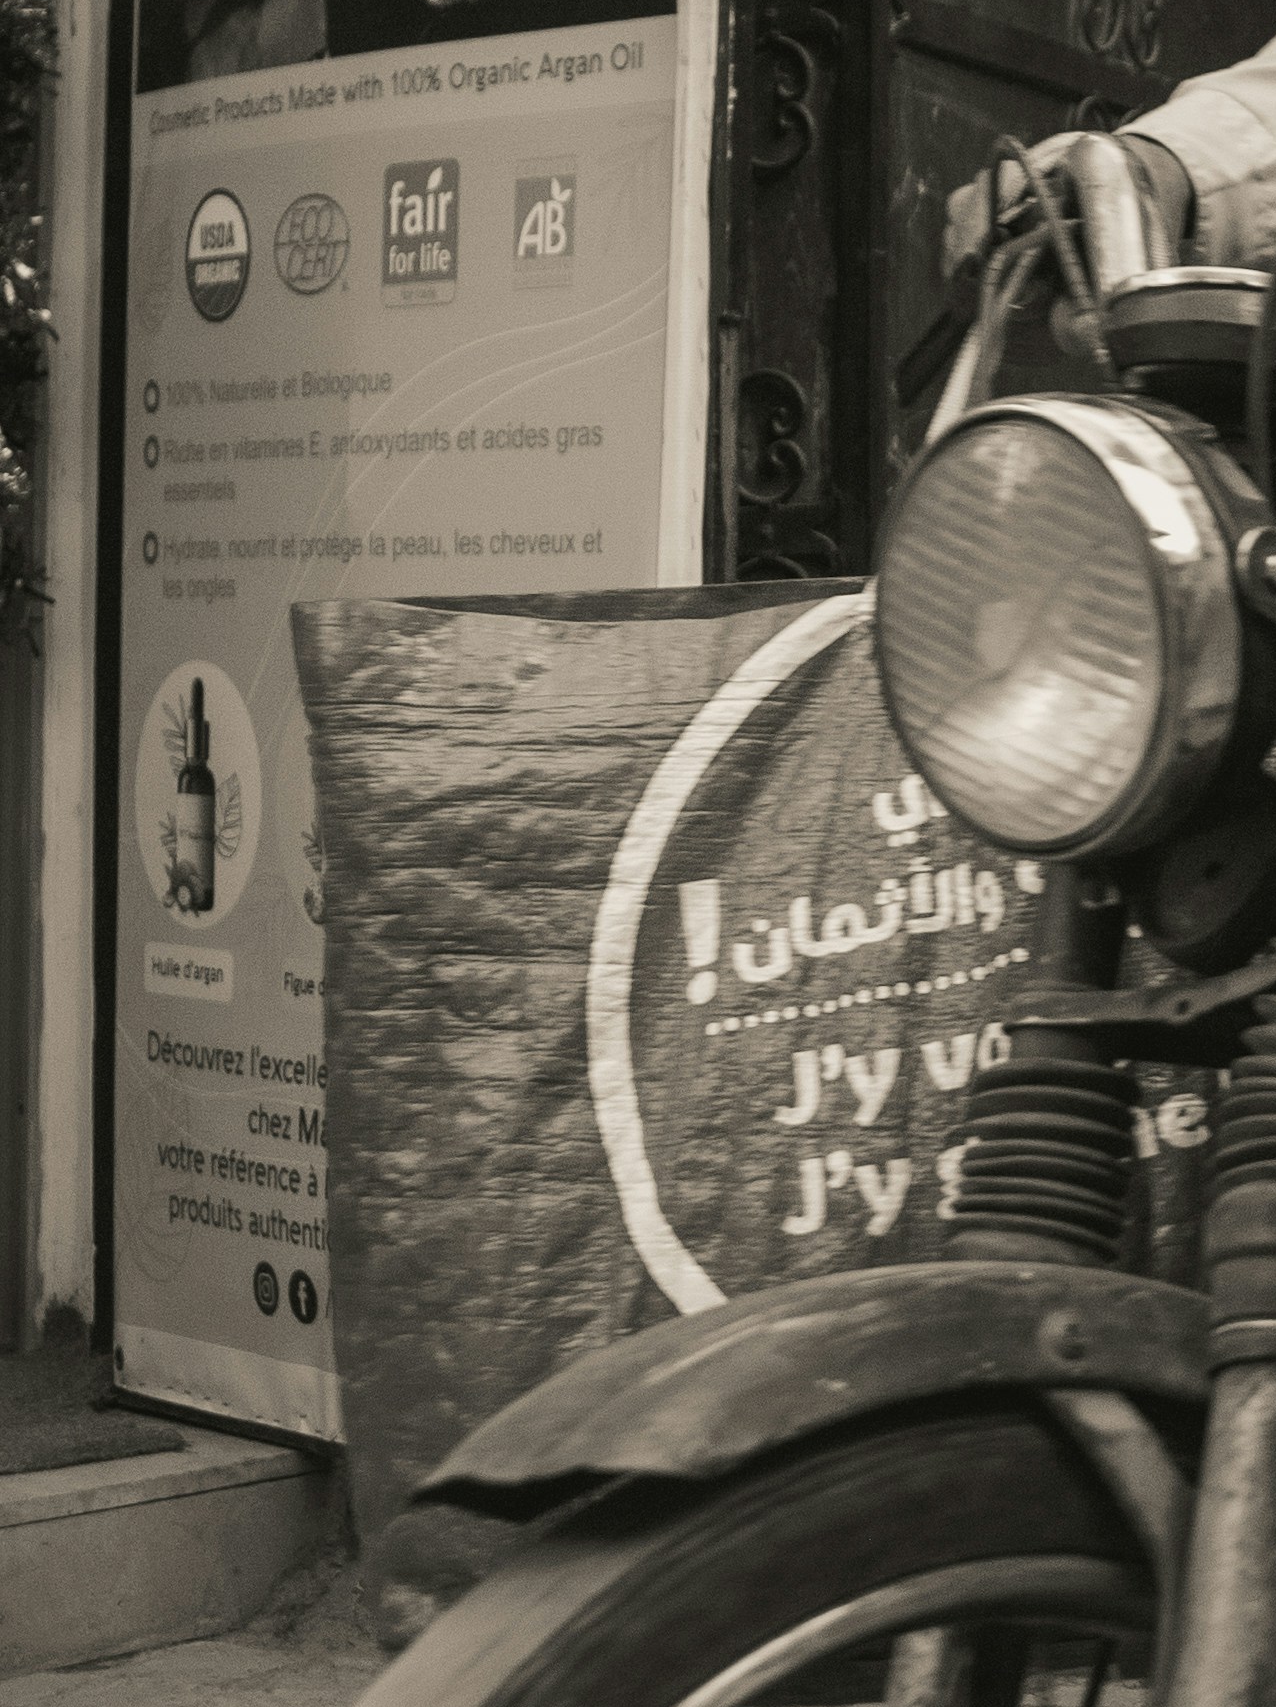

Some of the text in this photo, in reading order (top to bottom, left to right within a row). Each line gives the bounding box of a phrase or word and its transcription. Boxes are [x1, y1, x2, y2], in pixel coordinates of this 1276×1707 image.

[149, 41, 644, 136] Cosmetic Products Made with 100% Organic Argan Oil
[288, 200, 335, 244] ECO
[389, 169, 453, 236] fair
[200, 219, 235, 251] USDA
[517, 199, 567, 257] AB
[286, 242, 338, 283] CERT
[388, 241, 451, 276] for life
[281, 377, 298, 399] et
[301, 370, 393, 402] Biologique
[208, 442, 228, 462] en
[233, 435, 304, 461] vitamines
[329, 427, 450, 460] antioxydants
[456, 426, 477, 452] et
[481, 421, 550, 451] acides
[555, 424, 605, 455] gras
[368, 531, 386, 556] la
[392, 534, 448, 563] peau,
[453, 528, 483, 556] les
[489, 528, 576, 555] cheveux
[582, 530, 604, 555] et
[151, 956, 224, 986] Huile d'argan
[146, 1029, 245, 1076] Découvrez
[773, 1043, 901, 1127] J'y
[247, 1103, 292, 1140] chez
[157, 1141, 205, 1174] votre
[210, 1146, 301, 1194] référence
[307, 1164, 318, 1197] à
[168, 1194, 243, 1232] produits
[781, 1150, 913, 1237] J'y
